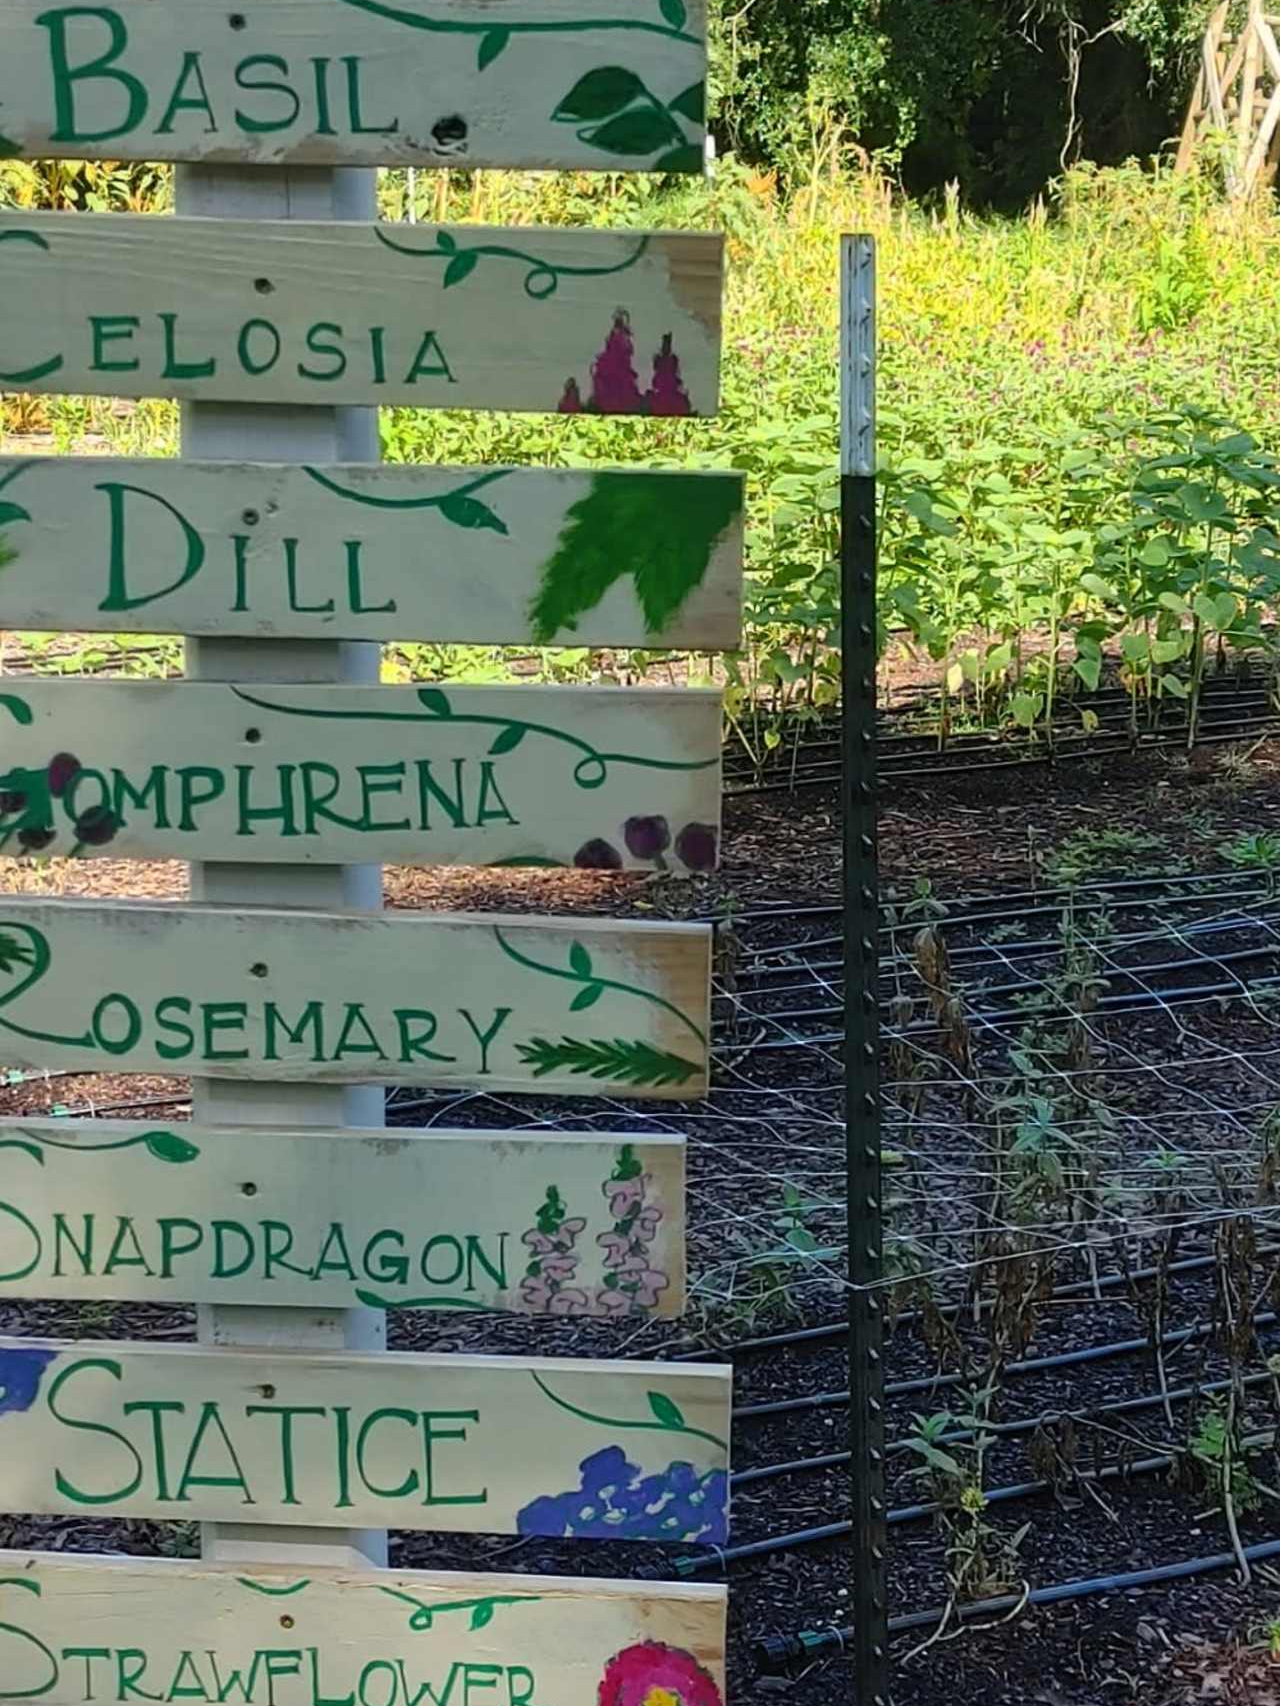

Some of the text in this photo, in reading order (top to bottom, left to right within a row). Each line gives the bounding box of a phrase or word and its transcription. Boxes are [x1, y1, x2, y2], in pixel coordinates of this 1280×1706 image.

[36, 5, 399, 144] BASIL
[93, 482, 397, 614] DILL
[47, 1359, 487, 1508] STATICE
